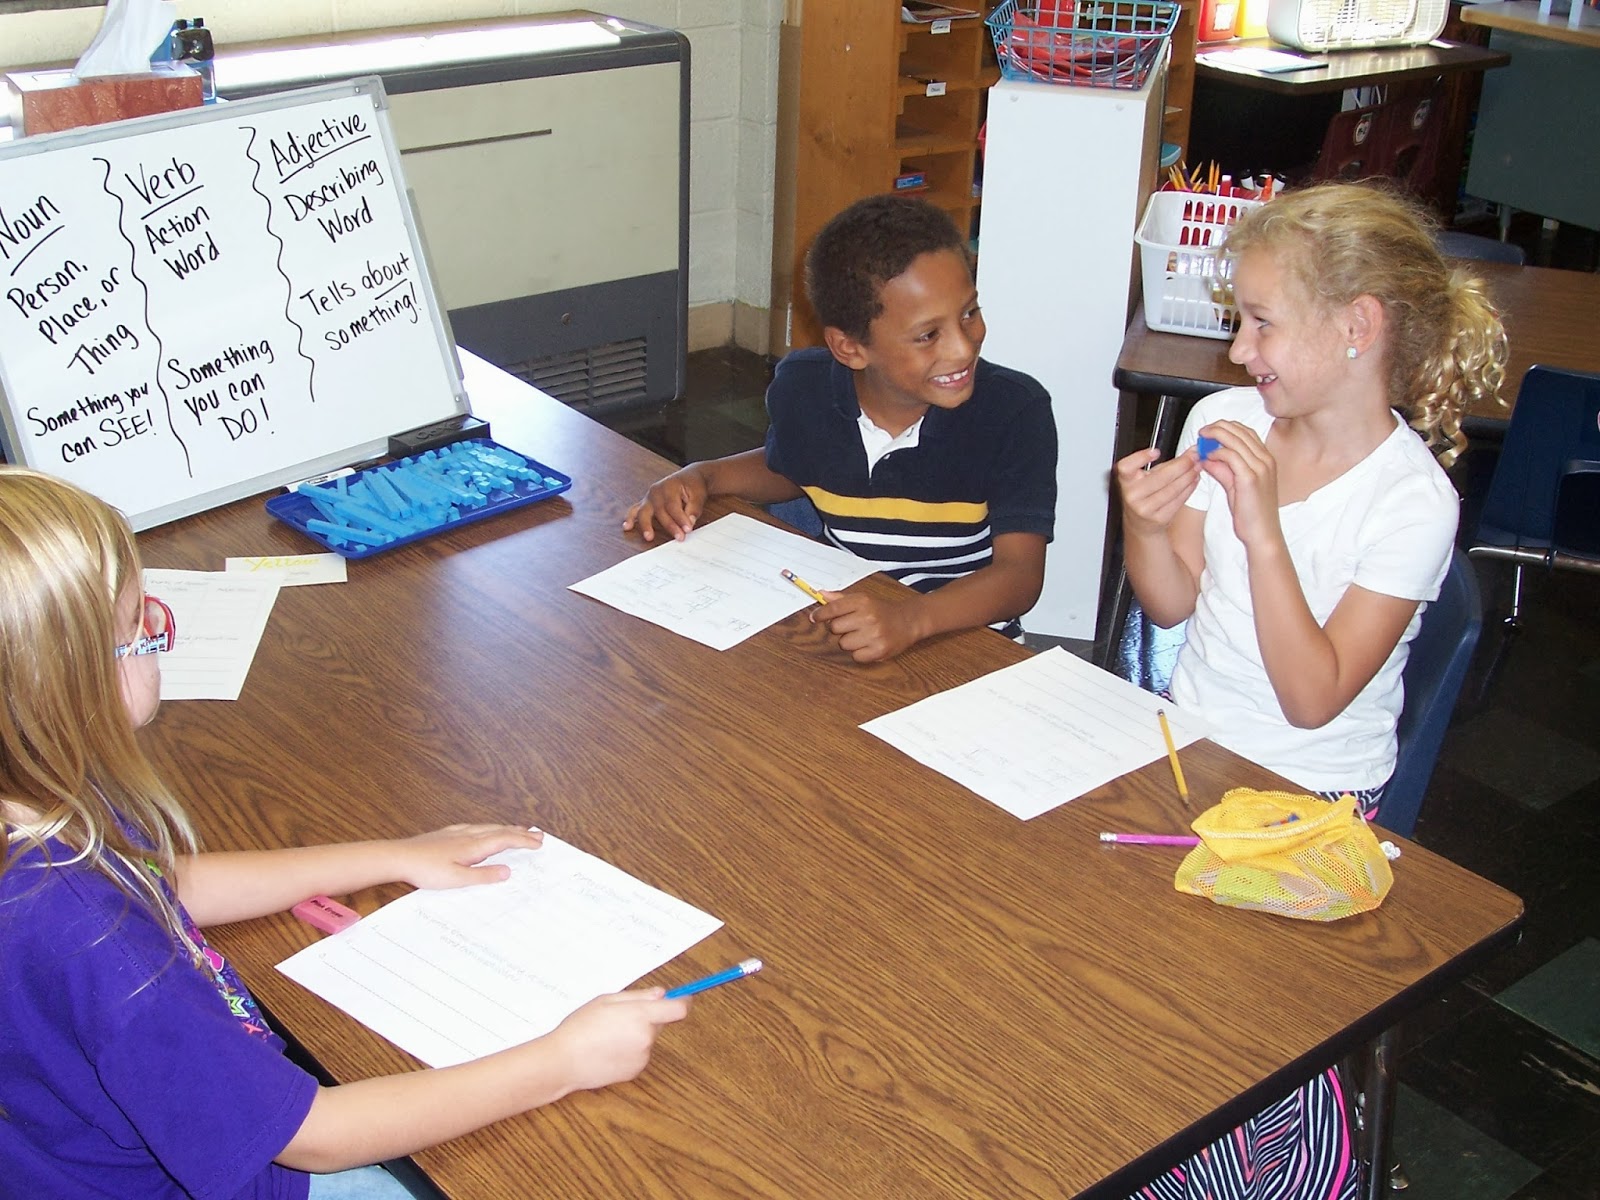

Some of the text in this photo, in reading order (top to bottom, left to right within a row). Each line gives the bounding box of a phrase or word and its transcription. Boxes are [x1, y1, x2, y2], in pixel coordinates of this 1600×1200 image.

[270, 115, 366, 176] Adjective
[125, 157, 195, 204] Verb
[284, 160, 383, 221] Describing
[0, 196, 60, 259] Noun
[145, 206, 209, 254] Action
[318, 196, 373, 243] Word
[101, 267, 119, 292] or
[163, 231, 219, 280] Word
[7, 261, 87, 318] Person,
[300, 253, 409, 315] Tells about
[67, 325, 139, 374] Thing
[168, 341, 274, 389] Something
[27, 383, 148, 436] Something you
[184, 373, 265, 426] you can
[218, 398, 274, 441] DO!
[100, 409, 156, 446] SEE!
